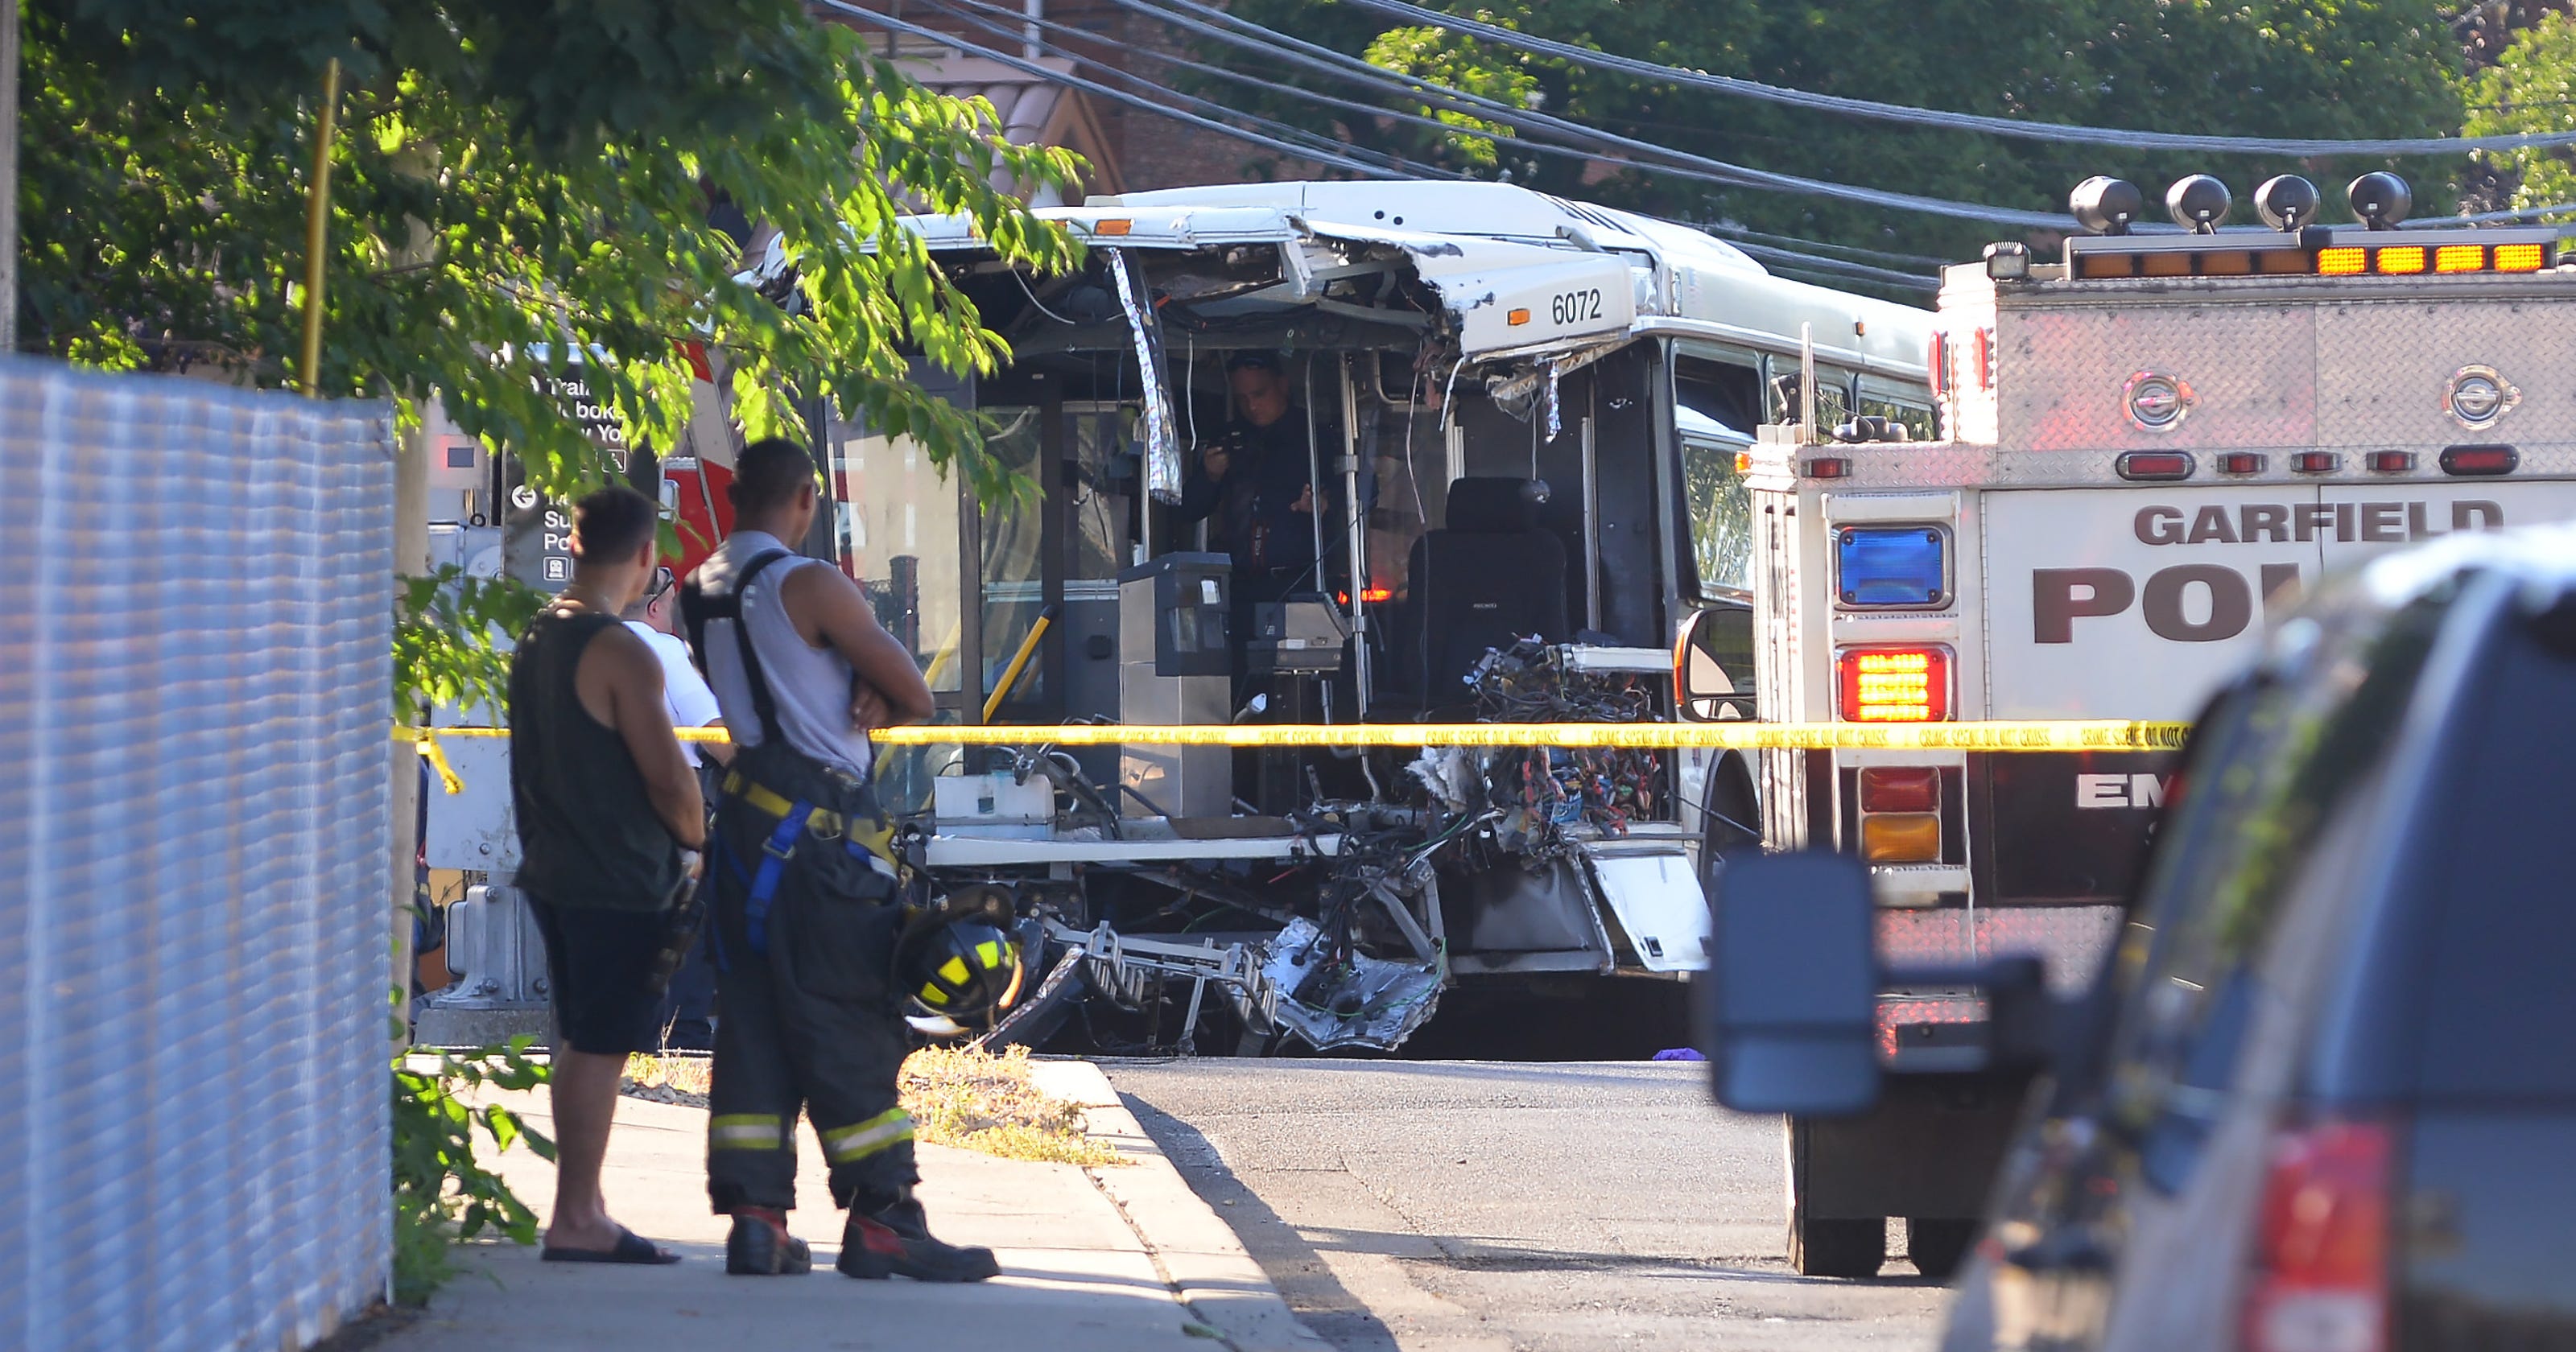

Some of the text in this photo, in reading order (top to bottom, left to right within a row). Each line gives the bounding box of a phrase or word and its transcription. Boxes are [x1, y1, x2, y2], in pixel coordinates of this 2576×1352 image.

[1552, 288, 1602, 325] 6072
[2134, 500, 2504, 545] GARFIELD
[2160, 727, 2181, 748] NOT
